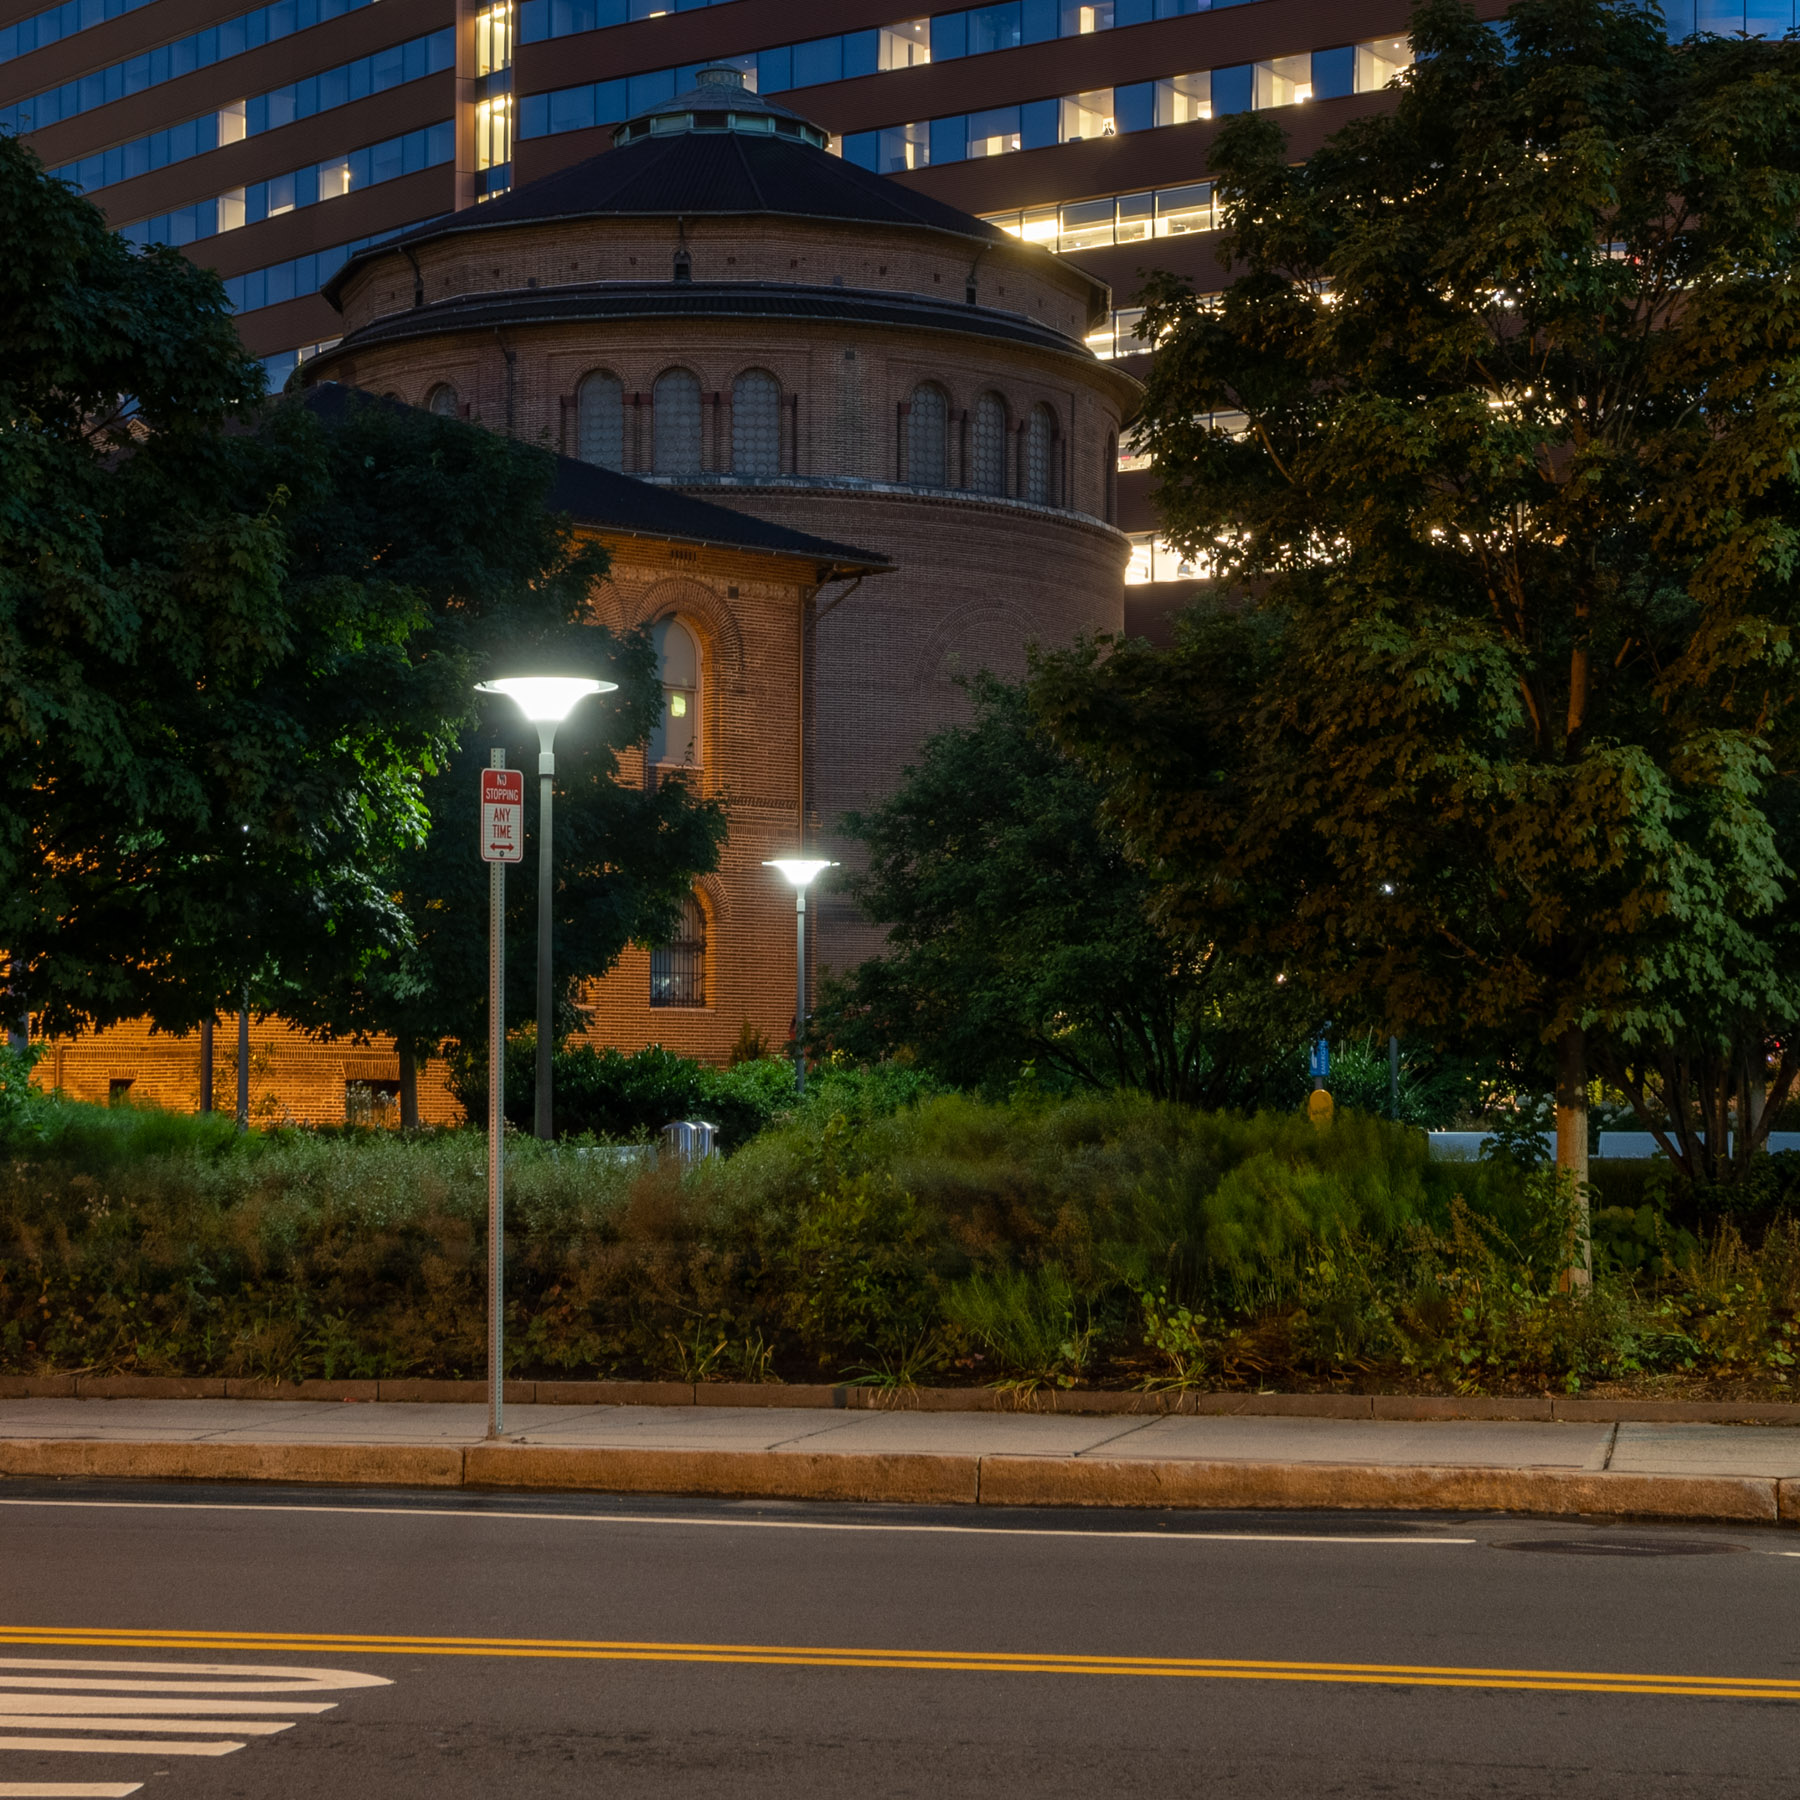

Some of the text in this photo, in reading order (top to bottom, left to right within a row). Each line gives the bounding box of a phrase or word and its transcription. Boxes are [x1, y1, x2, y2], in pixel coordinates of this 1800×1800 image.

[496, 774, 507, 786] NO
[485, 788, 519, 801] STOPPING
[493, 807, 511, 822] ANY
[492, 824, 512, 839] TIME
